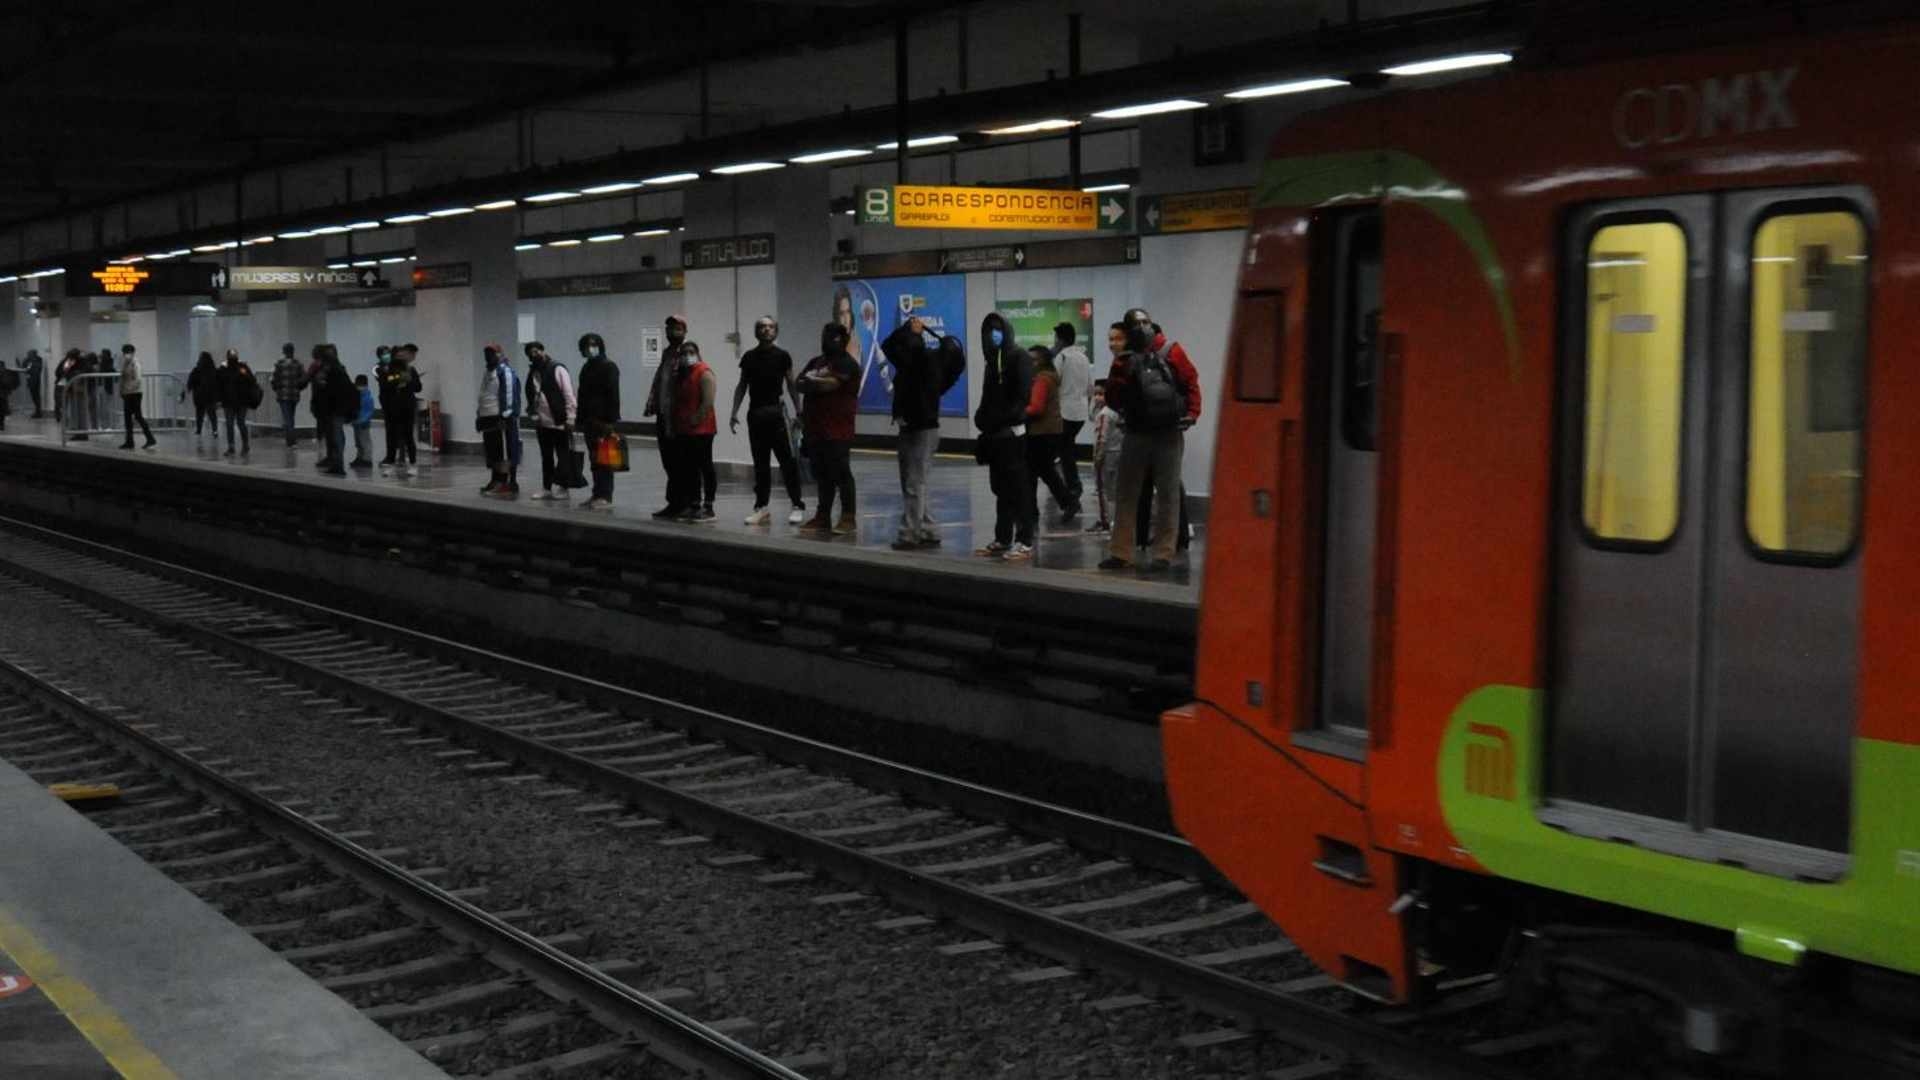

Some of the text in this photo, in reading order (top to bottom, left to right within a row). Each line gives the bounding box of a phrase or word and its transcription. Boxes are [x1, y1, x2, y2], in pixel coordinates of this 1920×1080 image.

[1613, 68, 1800, 147] CDMX
[866, 188, 889, 215] 8
[900, 191, 1094, 211] CORRESPONDENCIA
[231, 271, 300, 284] MUJERES
[303, 271, 315, 284] Y
